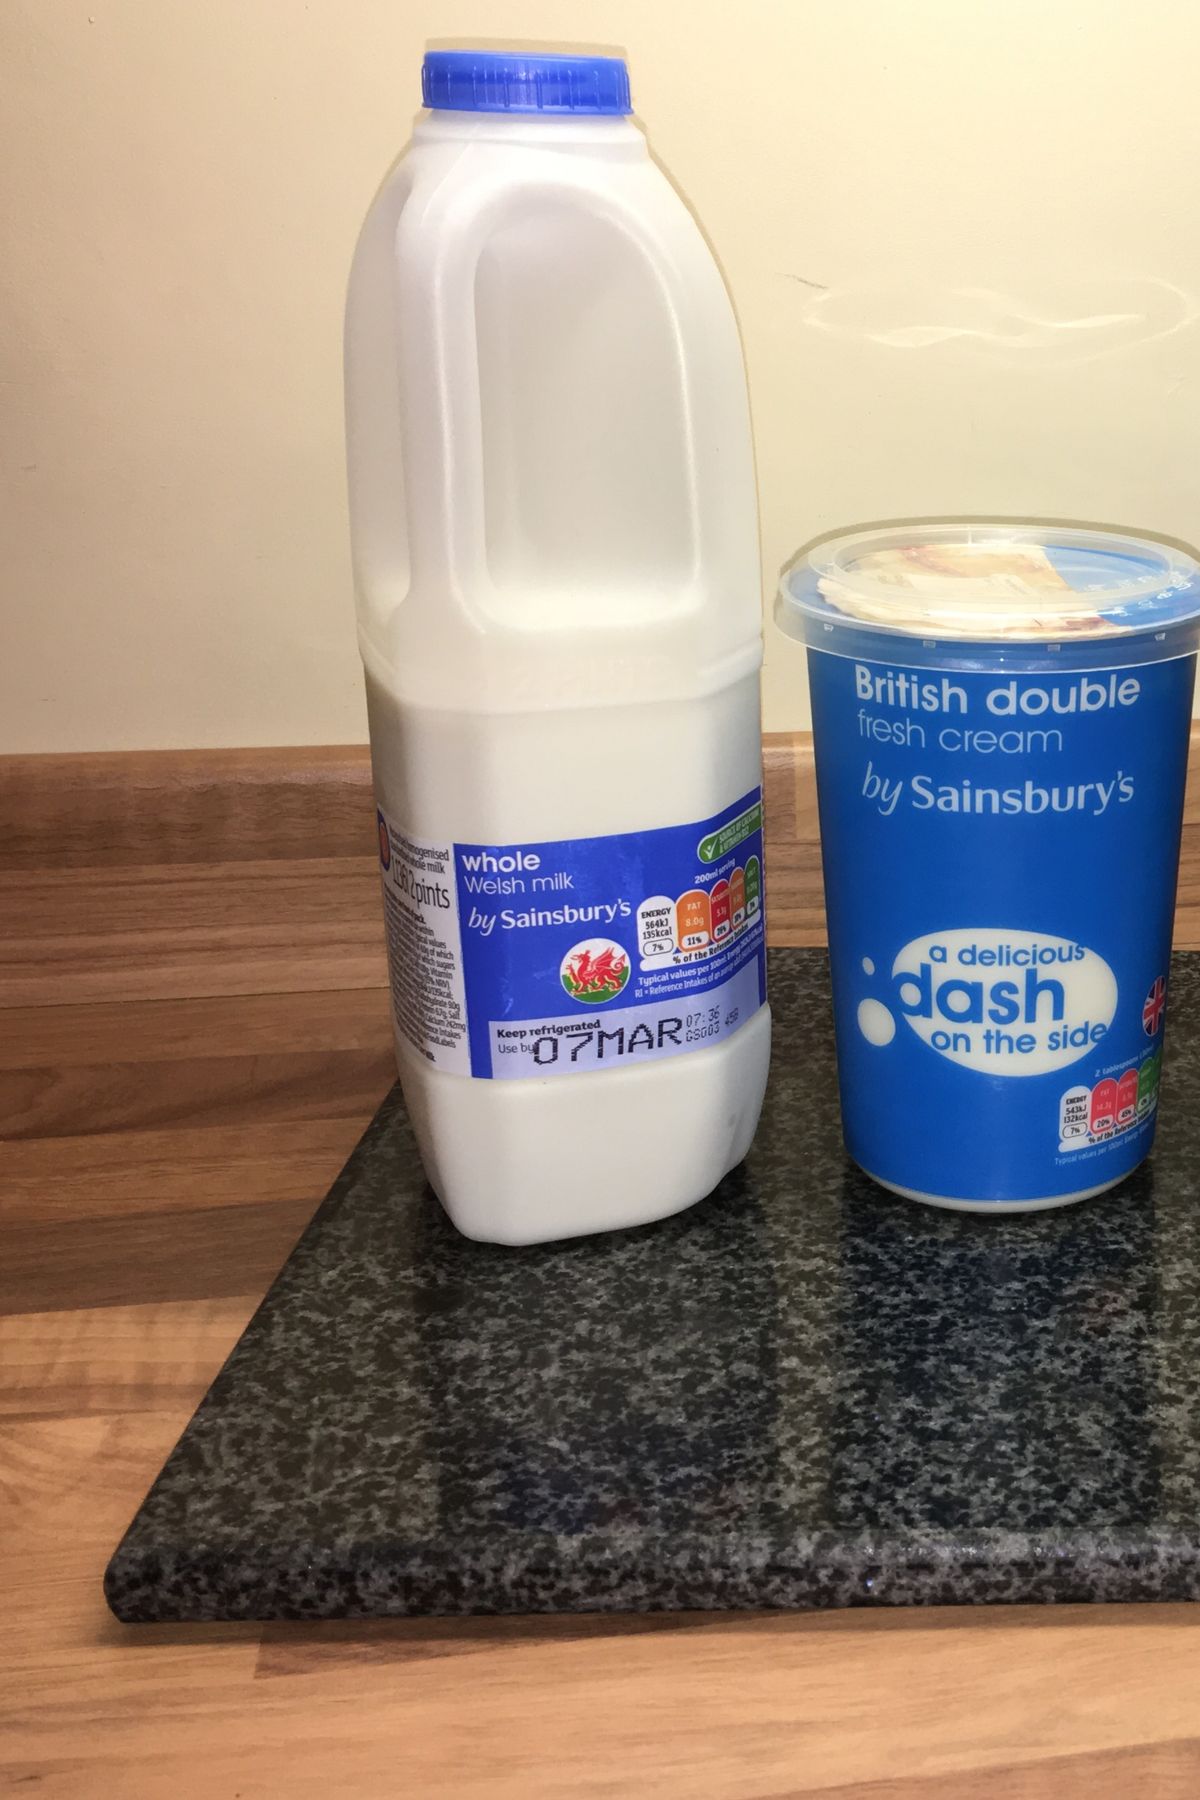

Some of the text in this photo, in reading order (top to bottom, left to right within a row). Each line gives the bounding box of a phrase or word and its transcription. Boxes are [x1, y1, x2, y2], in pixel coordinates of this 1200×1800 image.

[855, 665, 1141, 716] British double
[857, 709, 1063, 754] fresh cream
[861, 761, 1135, 816] by Sainsbury's
[427, 862, 446, 874] milk
[461, 853, 541, 872] whole
[694, 868, 718, 884] 200ml
[718, 858, 736, 876] serving
[464, 872, 574, 895] Welsh milk
[415, 879, 450, 909] pints
[641, 907, 672, 919] ENERGY
[687, 902, 701, 910] FAT
[468, 899, 632, 936] by Sainsbury's
[645, 919, 669, 930] 564kJ
[643, 927, 672, 939] 135kcal
[687, 937, 702, 945] 11%
[436, 949, 454, 960] which
[652, 943, 664, 952] 7%
[673, 955, 681, 963] %
[683, 953, 692, 963] of
[695, 951, 708, 960] the
[709, 939, 733, 956] Reference
[929, 944, 1086, 967] a delicious
[638, 972, 669, 986] Typical
[670, 967, 697, 979] values
[697, 964, 709, 975] per
[634, 989, 643, 998] RI
[649, 982, 683, 995] Reference
[684, 977, 707, 988] Intakes
[892, 963, 1065, 1025] dash
[497, 1019, 601, 1039] Keep refrigerated
[931, 1021, 1107, 1054] on the side
[497, 1018, 683, 1065] Use by 07MAR
[1066, 1095, 1087, 1105] ENERGY
[1063, 1112, 1088, 1124] 132kcal
[1071, 1126, 1080, 1135] 7%
[1096, 1133, 1103, 1142] of
[1104, 1130, 1113, 1139] the
